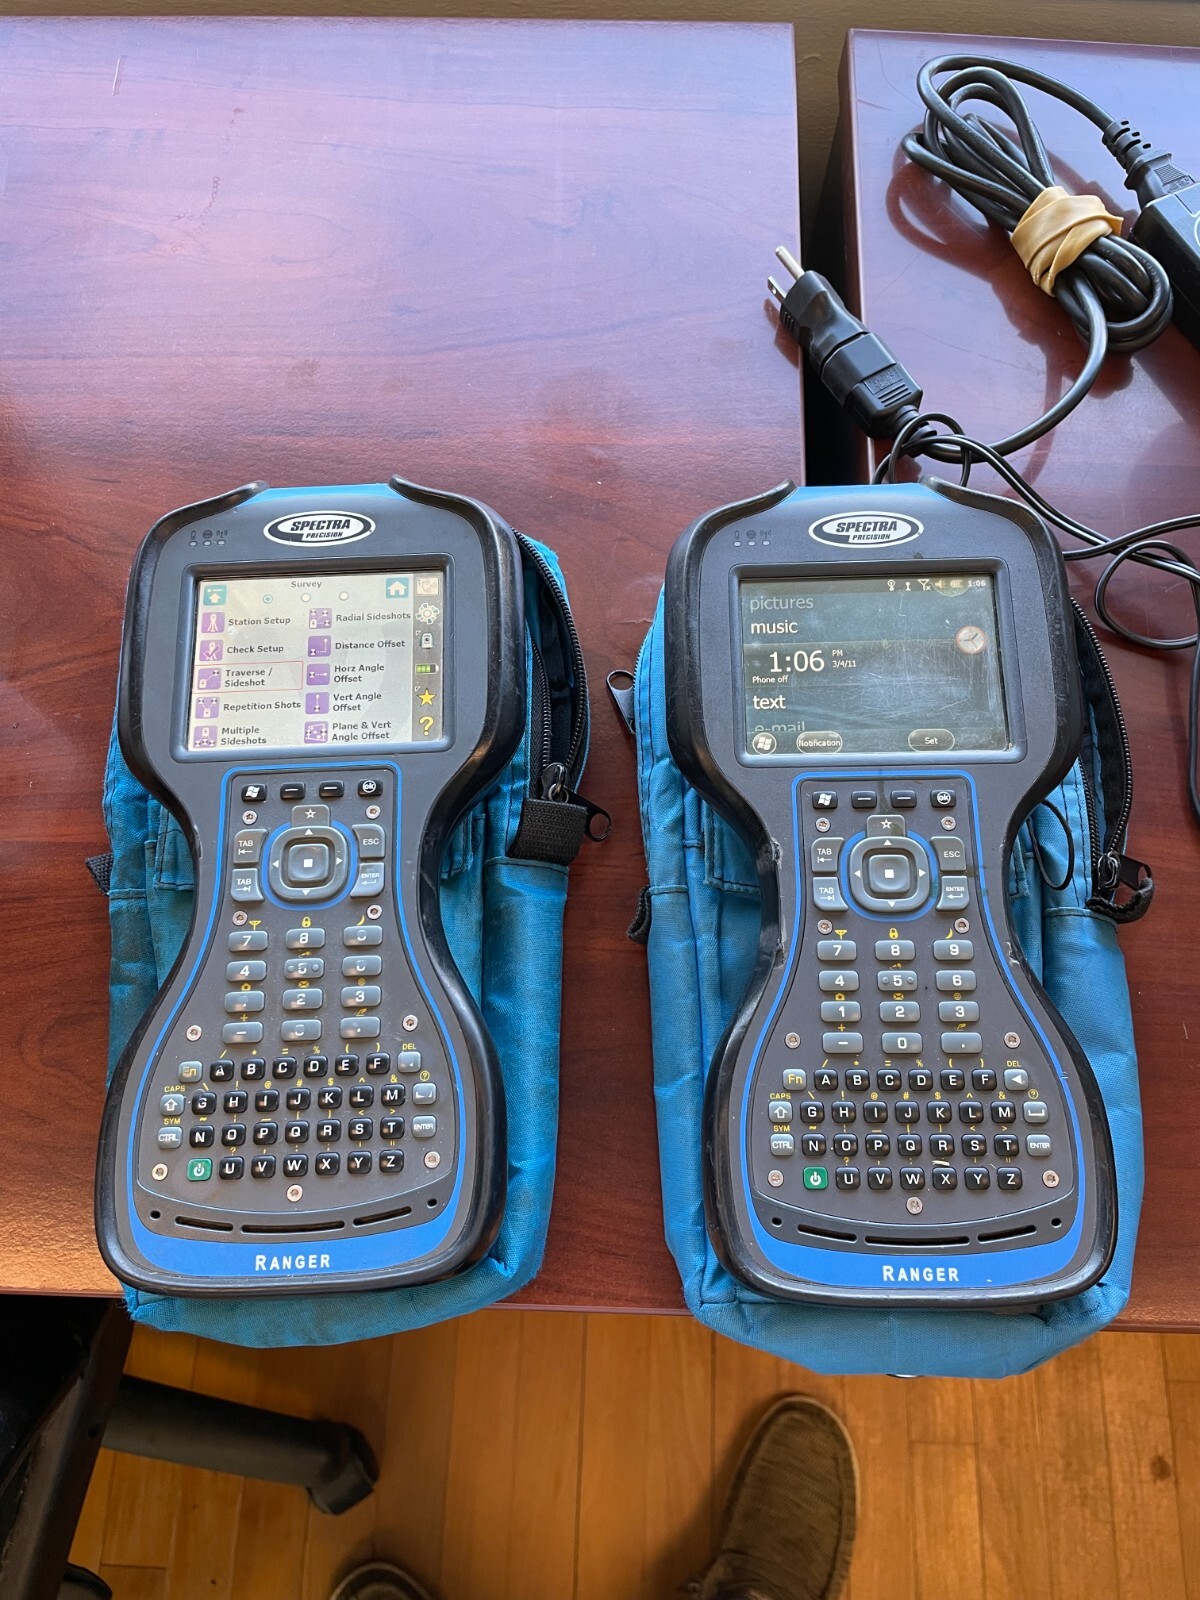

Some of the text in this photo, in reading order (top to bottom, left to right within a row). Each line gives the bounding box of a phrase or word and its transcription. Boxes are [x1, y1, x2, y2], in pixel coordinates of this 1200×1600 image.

[290, 519, 350, 531] SPECTRA
[836, 521, 897, 532] SPECTRA
[291, 580, 322, 589] Survey
[750, 596, 813, 613] pictures
[228, 617, 291, 626] Station Setup
[336, 612, 411, 621] Radial Sideshots
[751, 620, 798, 634] music
[335, 639, 405, 649] Distance Offset
[227, 645, 284, 654] Check Setup
[770, 650, 825, 673] 1:06
[832, 660, 857, 668] 3/4/11
[226, 668, 265, 677] Traverse
[334, 664, 384, 673] Horz Angle
[225, 678, 265, 687] Sideshot
[334, 675, 362, 683] Offset
[753, 676, 775, 684] Phone
[333, 692, 382, 702] Vert Angle
[753, 695, 786, 709] text
[223, 701, 301, 711] Repetition Shots
[333, 703, 361, 712] Offset
[333, 721, 358, 730] Plane
[371, 721, 391, 729] Vert
[755, 721, 805, 731] e-mail
[222, 726, 259, 736] Multiple
[221, 736, 267, 745] Sideshots
[332, 731, 389, 742] Angle Offset
[925, 737, 938, 745] Set
[799, 739, 840, 747] Notification
[242, 936, 251, 946] 7
[833, 945, 842, 956] 7
[891, 945, 900, 955] 8
[950, 944, 959, 955] 9
[240, 965, 249, 976] 4
[835, 975, 845, 986] 4
[894, 975, 902, 986] 5
[953, 975, 962, 986] 6
[297, 994, 305, 1005] 2
[356, 991, 365, 1002] 3
[838, 1006, 845, 1017] 1
[895, 1006, 904, 1017] 2
[955, 1006, 964, 1017] 3
[898, 1038, 907, 1049] 0
[278, 1062, 287, 1073] C
[310, 1061, 319, 1072] D
[342, 1060, 349, 1070] E
[374, 1058, 380, 1068] F
[216, 1066, 224, 1076] A
[247, 1064, 255, 1074] B
[788, 1074, 802, 1084] Fn
[822, 1075, 830, 1085] A
[853, 1075, 861, 1085] B
[885, 1075, 894, 1085] C
[917, 1075, 926, 1085] D
[949, 1075, 957, 1085] E
[982, 1074, 988, 1084] F
[294, 1094, 301, 1104] J
[325, 1093, 333, 1103] K
[357, 1091, 364, 1102] L
[386, 1090, 398, 1100] M
[198, 1098, 207, 1108] G
[229, 1097, 238, 1107] H
[808, 1107, 816, 1117] G
[840, 1107, 848, 1117] H
[905, 1108, 911, 1118] J
[936, 1108, 945, 1118] K
[969, 1108, 976, 1118] L
[998, 1107, 1010, 1117] M
[291, 1126, 300, 1137] Q
[323, 1125, 332, 1136] R
[355, 1124, 364, 1134] S
[388, 1122, 396, 1133] T
[159, 1134, 178, 1142] CTRL
[196, 1132, 205, 1142] N
[260, 1128, 268, 1138] P
[809, 1141, 818, 1151] N
[874, 1141, 882, 1150] P
[906, 1140, 915, 1151] Q
[939, 1141, 947, 1150] R
[971, 1140, 980, 1151] S
[1003, 1140, 1011, 1150] T
[258, 1161, 267, 1172] V
[288, 1160, 302, 1170] W
[322, 1159, 330, 1169] X
[354, 1157, 363, 1168] Y
[387, 1156, 395, 1167] Z
[225, 1163, 234, 1174] U
[844, 1174, 853, 1184] U
[876, 1174, 885, 1184] V
[906, 1174, 920, 1184] W
[941, 1174, 950, 1184] X
[974, 1174, 982, 1184] Y
[1007, 1174, 1015, 1184] Z
[255, 1254, 330, 1271] RANGER
[882, 1266, 959, 1281] RANGER
